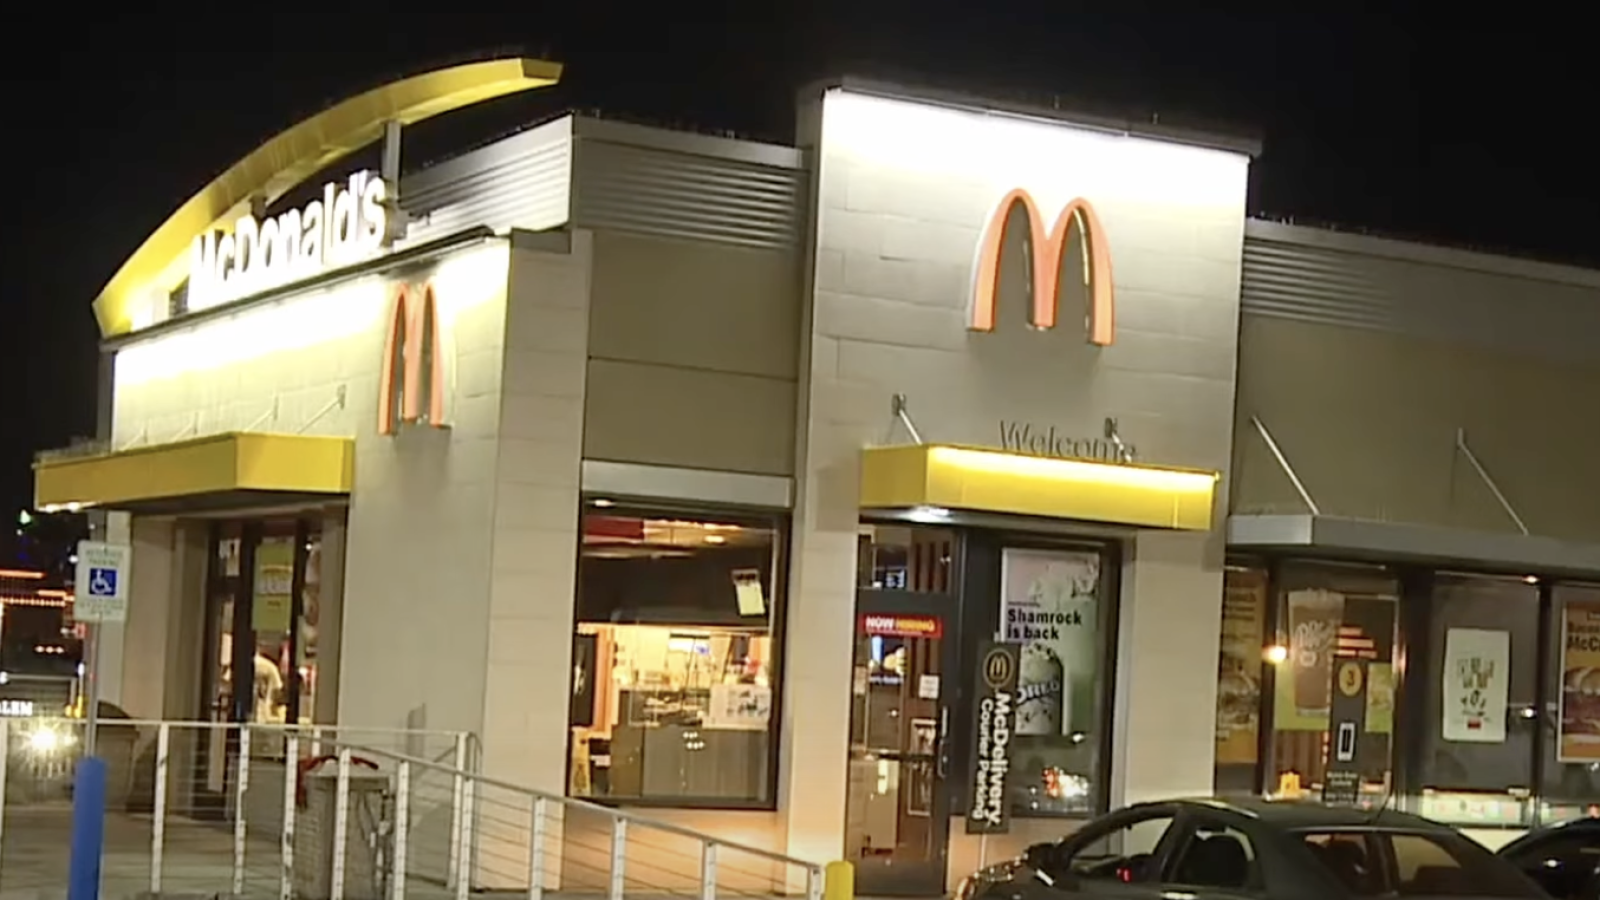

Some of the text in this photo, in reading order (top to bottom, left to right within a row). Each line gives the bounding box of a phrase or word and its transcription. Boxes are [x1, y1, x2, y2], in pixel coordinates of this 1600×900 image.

[187, 169, 386, 306] McDonald's
[1007, 608, 1082, 626] Shamrock
[1007, 624, 1059, 640] is back
[971, 698, 994, 820] Courier Parking
[984, 691, 1012, 827] McDelivery
